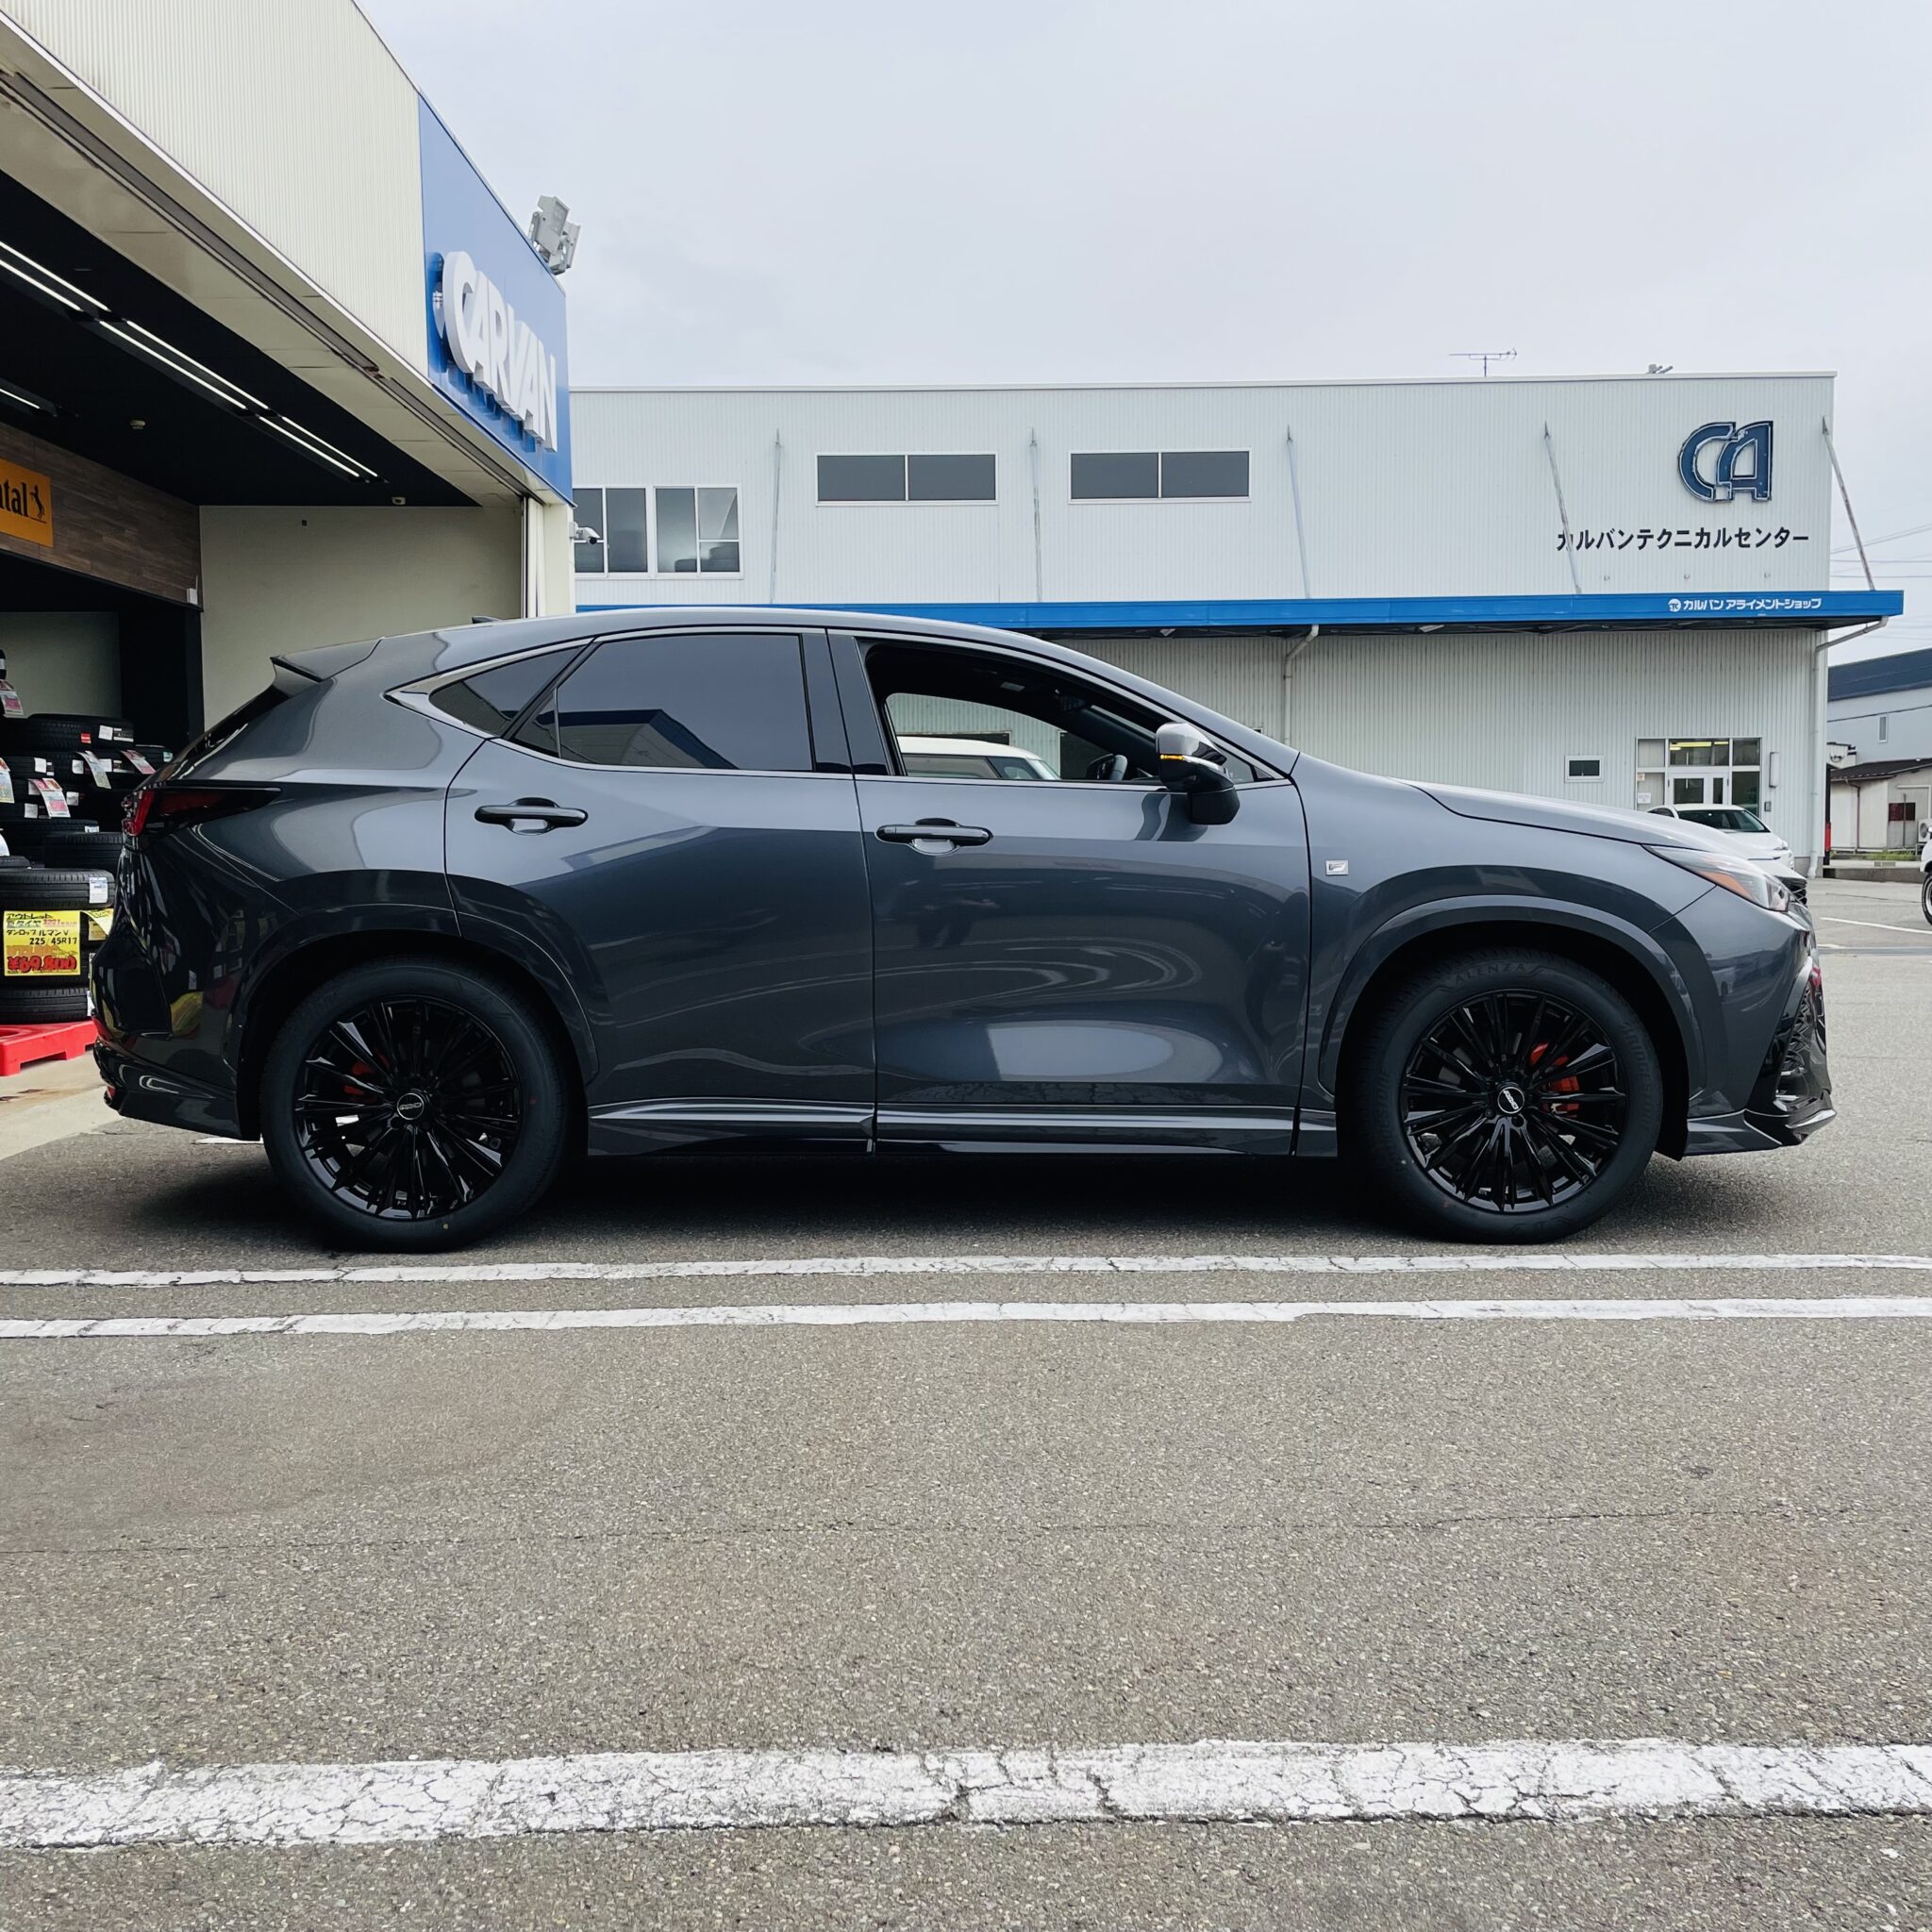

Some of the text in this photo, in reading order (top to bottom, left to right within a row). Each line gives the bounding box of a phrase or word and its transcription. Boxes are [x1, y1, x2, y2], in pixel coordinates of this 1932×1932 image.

[442, 251, 558, 453] CARVAN
[1557, 526, 1809, 551] カルバンテクニカルセンター
[1683, 599, 1724, 611] カルバン
[1725, 598, 1822, 610] アライメントショップ
